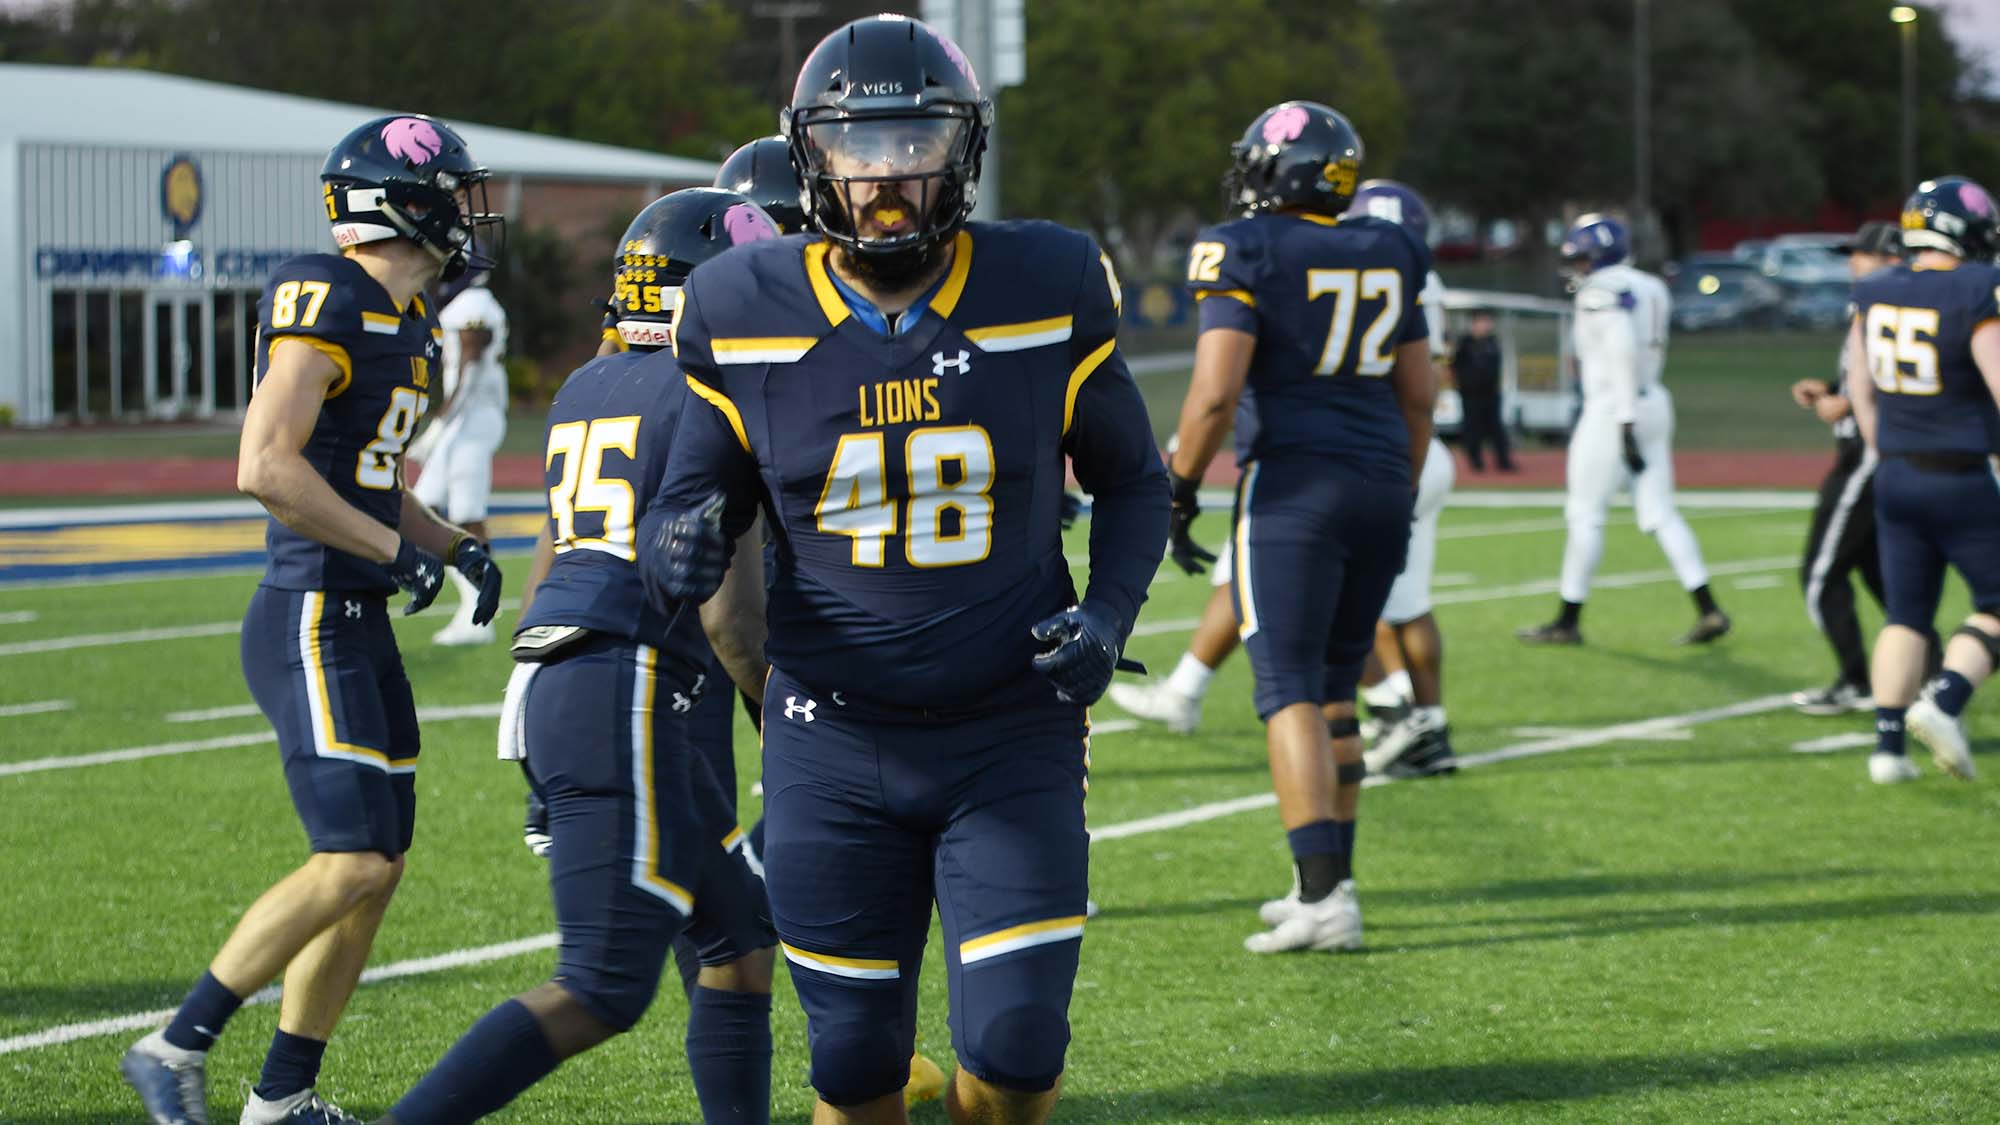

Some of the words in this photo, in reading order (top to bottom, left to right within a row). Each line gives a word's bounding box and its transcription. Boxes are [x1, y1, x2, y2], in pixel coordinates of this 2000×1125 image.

[862, 81, 903, 96] VICIS
[271, 280, 331, 328] 87
[626, 284, 661, 312] 35
[1307, 268, 1403, 376] 72
[620, 326, 673, 343] Riddel
[1867, 303, 1943, 394] 65
[859, 377, 941, 427] LIONS
[546, 415, 642, 562] 35
[814, 423, 996, 568] 48
